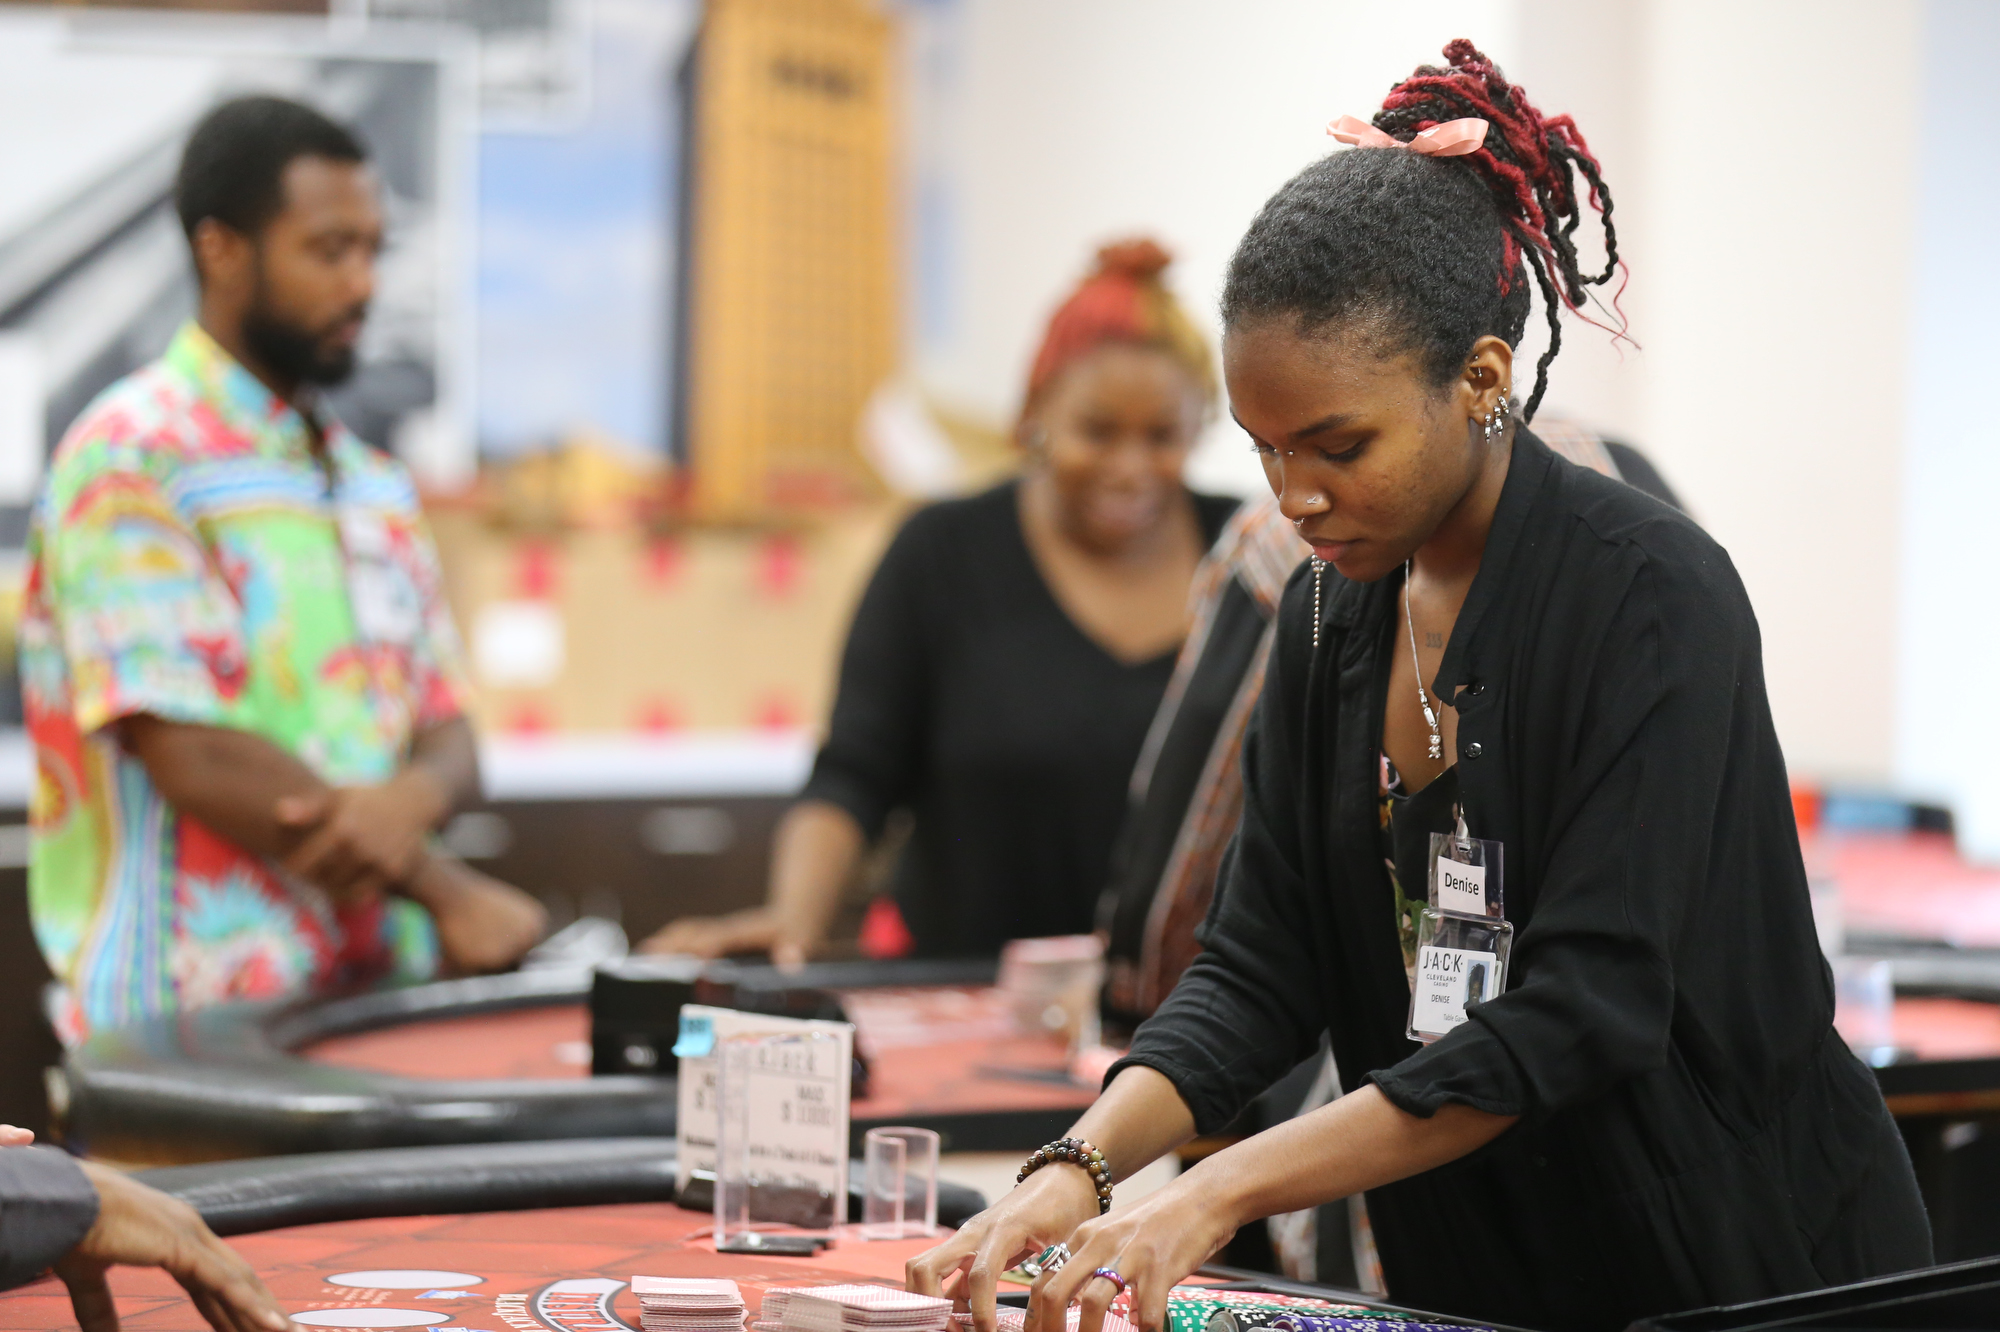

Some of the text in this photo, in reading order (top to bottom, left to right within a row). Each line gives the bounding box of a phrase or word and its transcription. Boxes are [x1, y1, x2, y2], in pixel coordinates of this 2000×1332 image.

[1445, 872, 1479, 896] Denise
[1426, 973, 1457, 983] CLEVELAND
[1431, 994, 1450, 1004] DENISE
